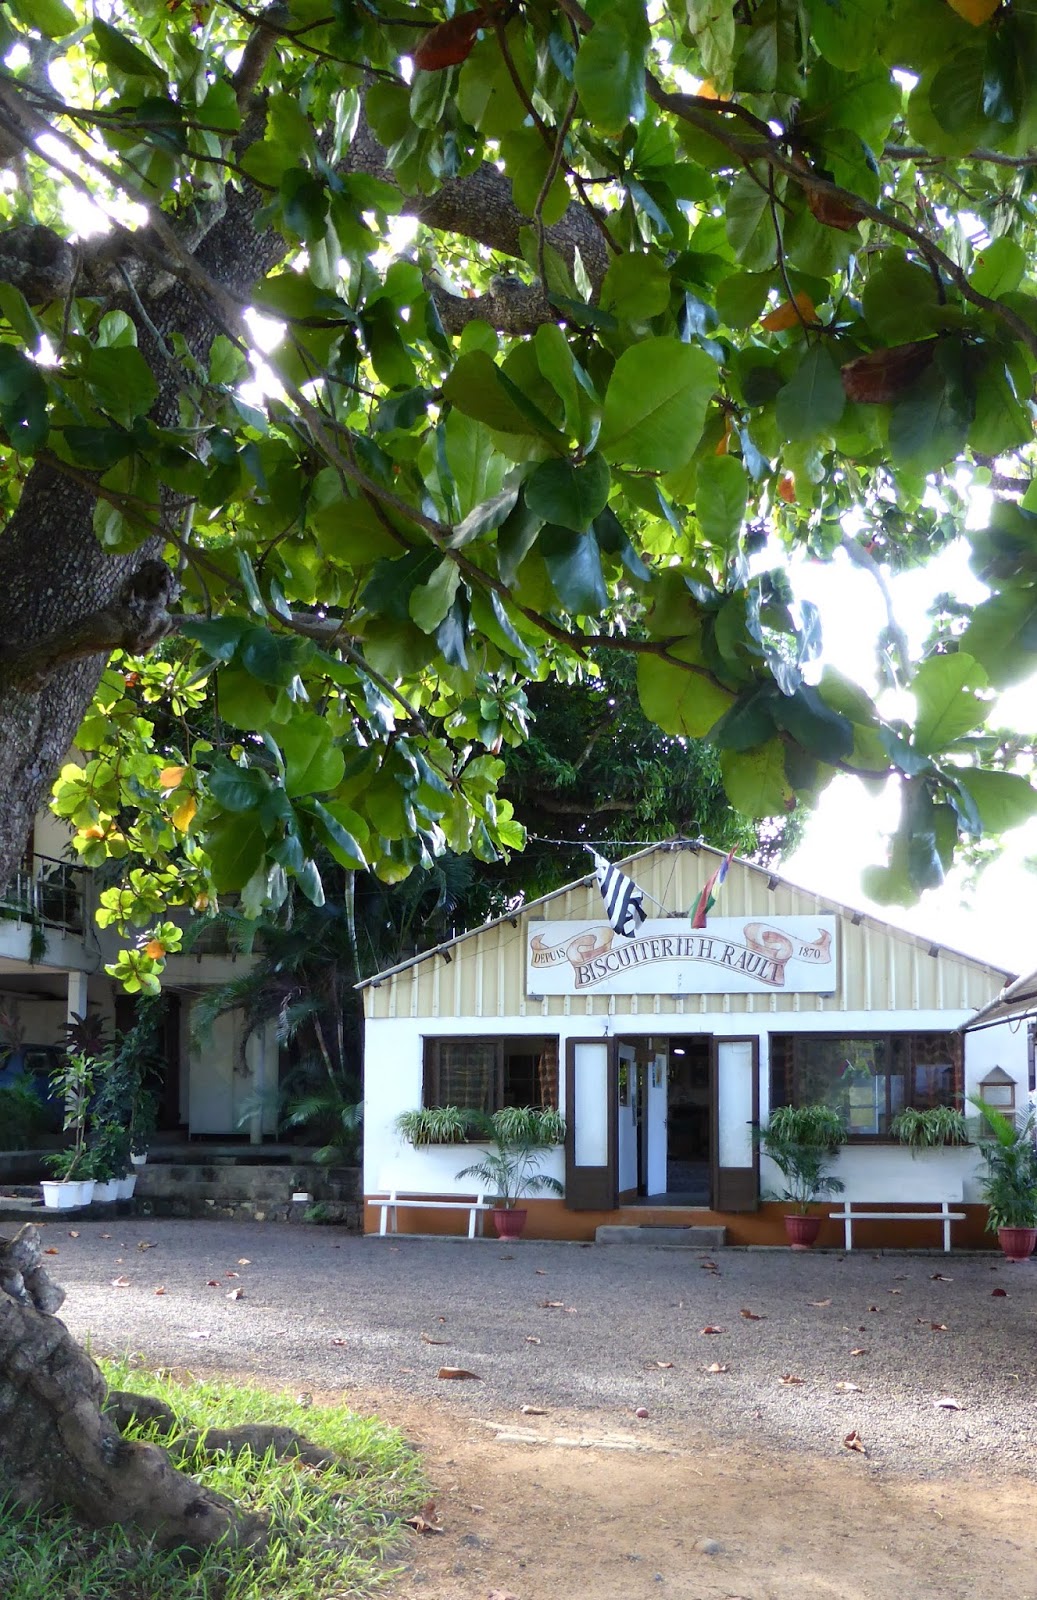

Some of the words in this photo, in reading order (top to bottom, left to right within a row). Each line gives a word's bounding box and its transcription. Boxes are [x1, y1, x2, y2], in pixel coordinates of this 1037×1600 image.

[533, 947, 566, 964] DEPUIS
[577, 937, 694, 985] BISCUITERIE
[698, 938, 716, 960] H.
[720, 944, 784, 982] RAULT
[799, 946, 821, 959] 1870
